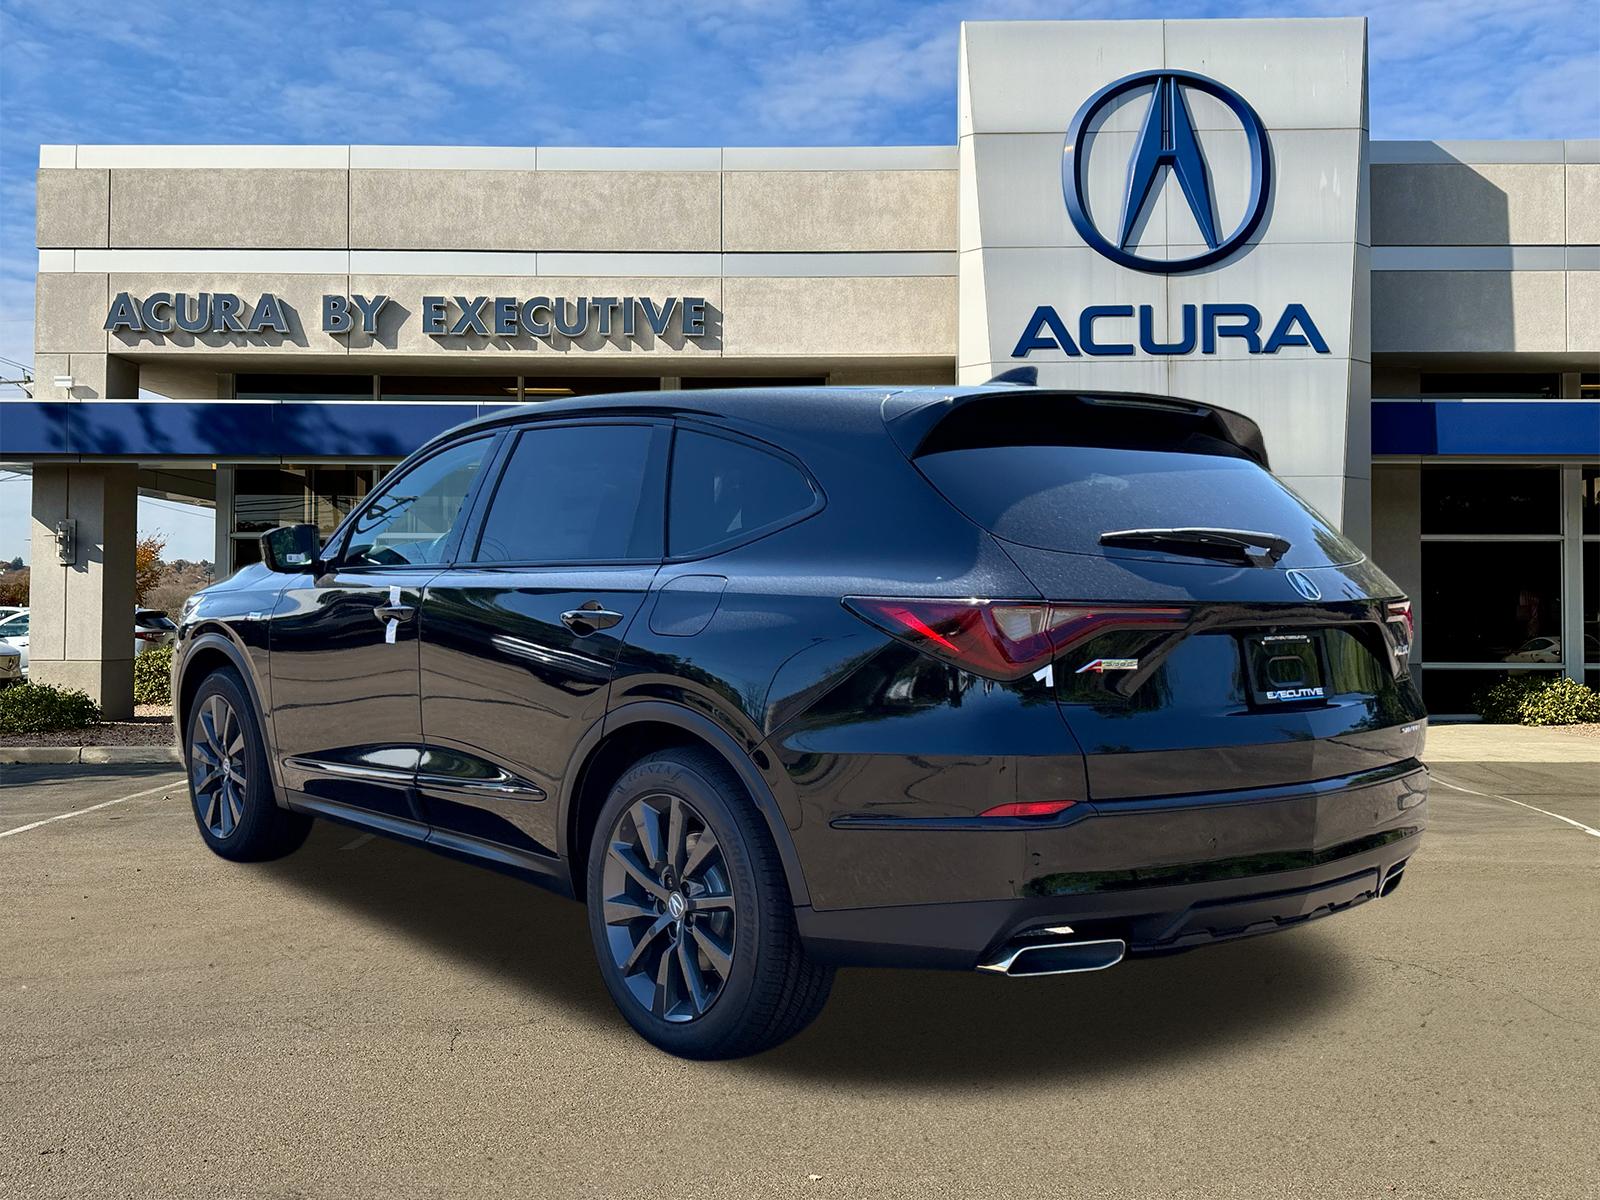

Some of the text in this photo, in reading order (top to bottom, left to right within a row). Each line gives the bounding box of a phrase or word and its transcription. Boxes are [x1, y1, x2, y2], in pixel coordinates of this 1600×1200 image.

[104, 292, 706, 338] ACURA BY EXECUTIVE
[1011, 303, 1330, 358] ACURA
[1266, 687, 1324, 700] EXECUTIVE
